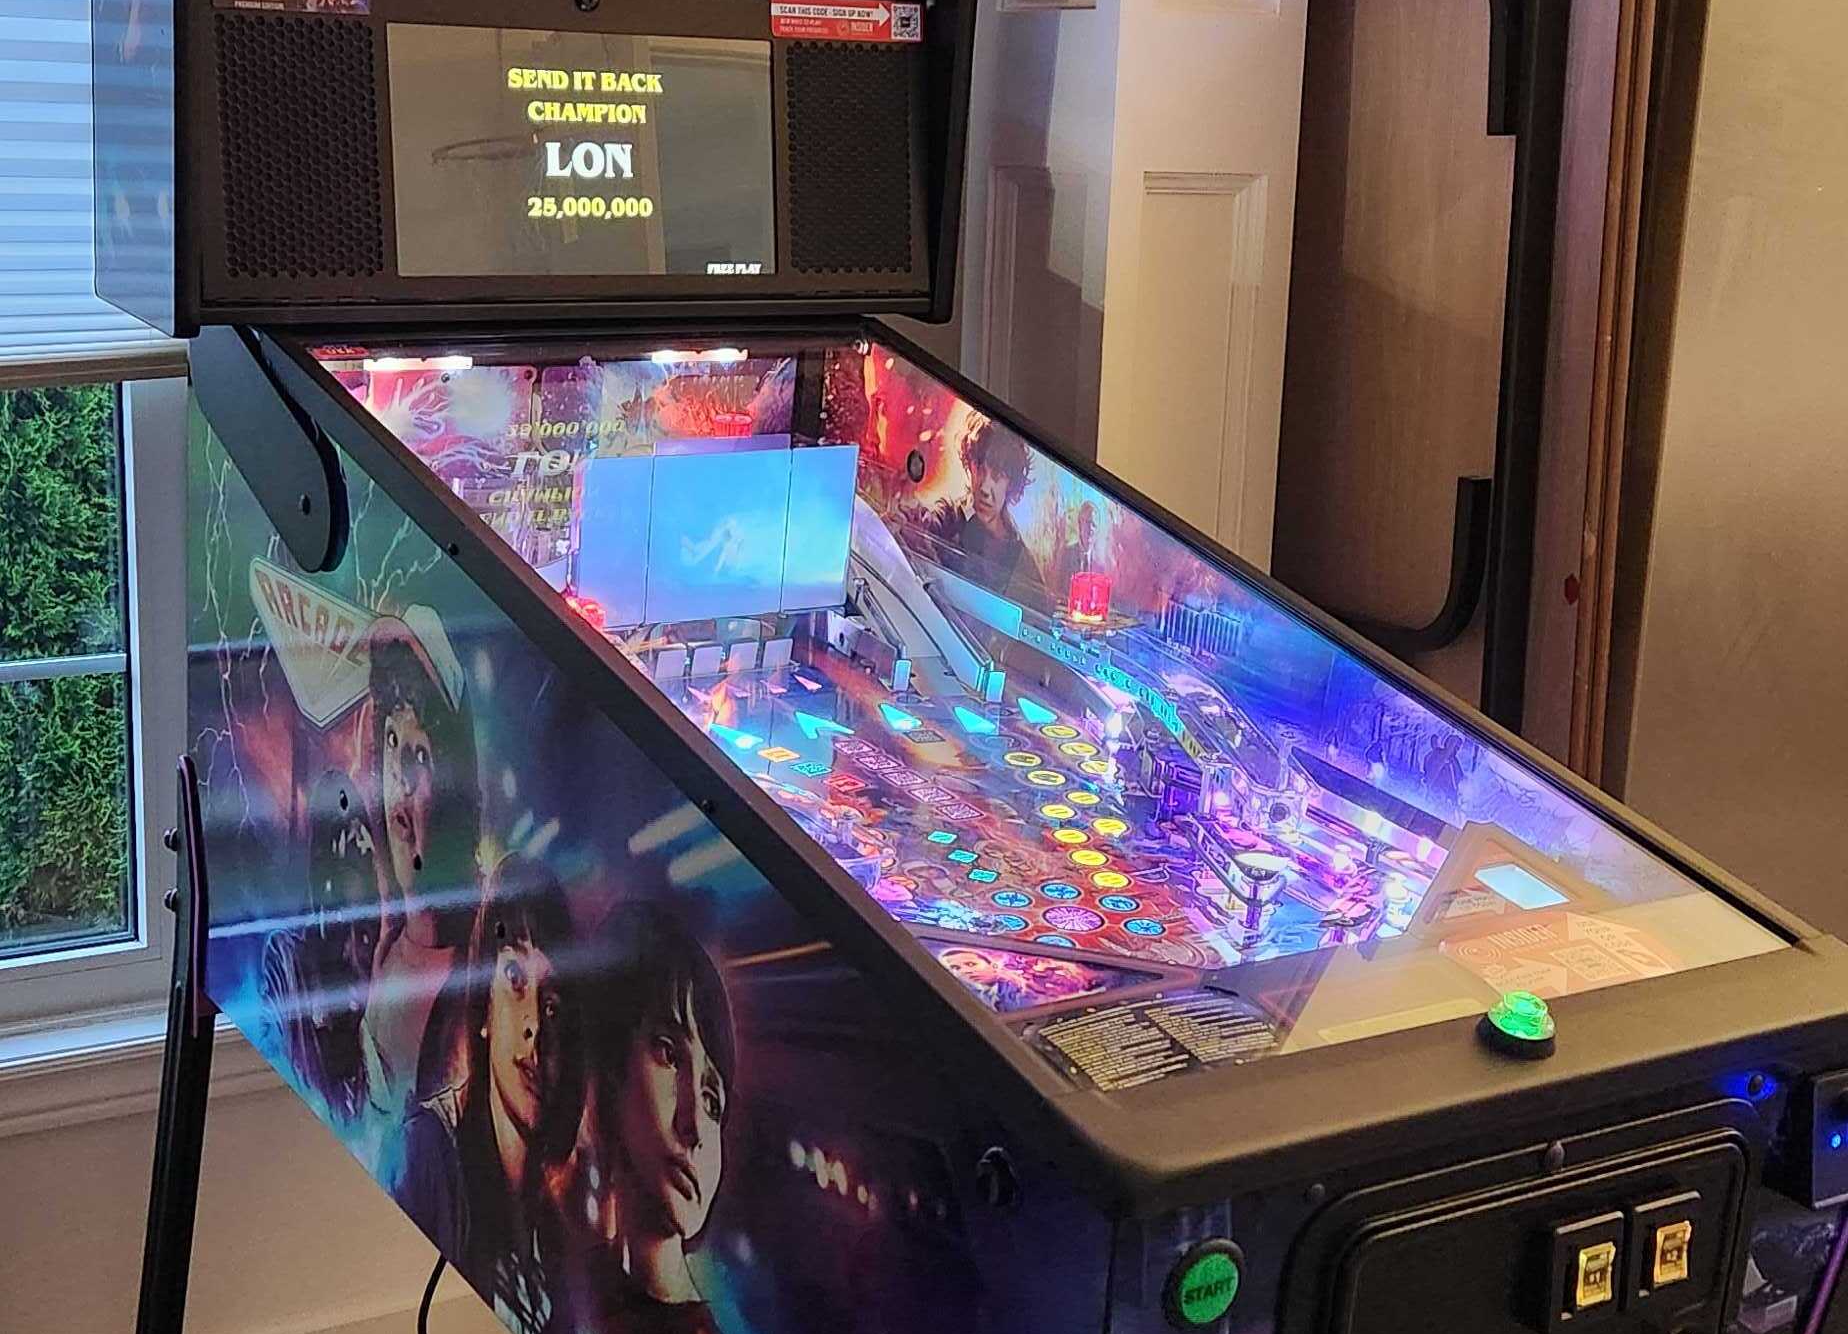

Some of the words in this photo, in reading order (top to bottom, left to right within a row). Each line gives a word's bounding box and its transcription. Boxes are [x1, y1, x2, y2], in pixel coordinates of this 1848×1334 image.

[779, 5, 797, 15] SCAN
[798, 6, 812, 16] THIS
[812, 7, 828, 17] CODE
[832, 8, 847, 18] SIGN
[848, 9, 856, 18] UP
[507, 67, 569, 90] SEND
[573, 70, 598, 91] IT
[600, 71, 664, 93] BACK
[527, 101, 647, 124] CHAMPION
[545, 141, 634, 179] LON
[527, 196, 654, 219] 25,000,000
[706, 262, 734, 275] FREE
[734, 262, 762, 275] PLAY
[1184, 1275, 1237, 1305] START
